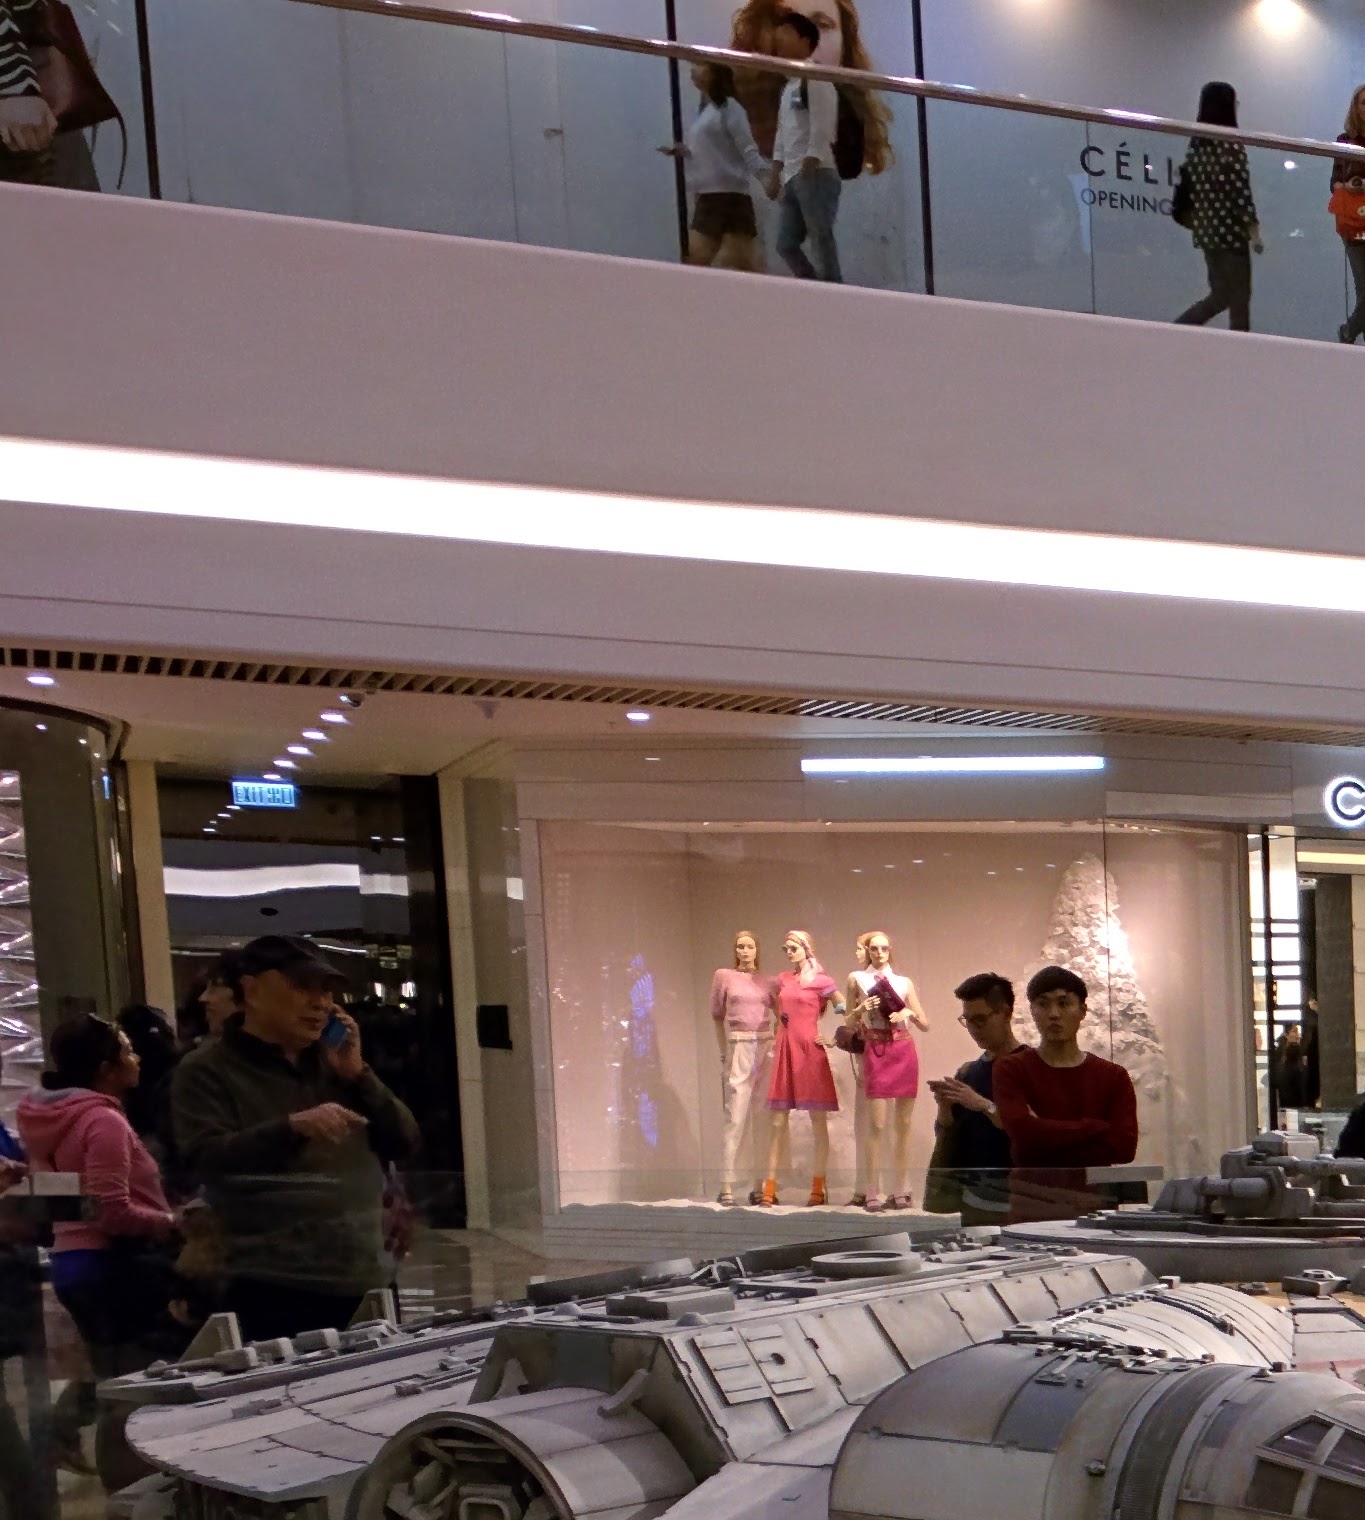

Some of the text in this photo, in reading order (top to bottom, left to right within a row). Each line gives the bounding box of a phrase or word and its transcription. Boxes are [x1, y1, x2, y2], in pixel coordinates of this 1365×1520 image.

[1080, 141, 1173, 187] CÉLI
[1081, 188, 1174, 216] OPENING
[234, 785, 293, 805] EXIT 出口
